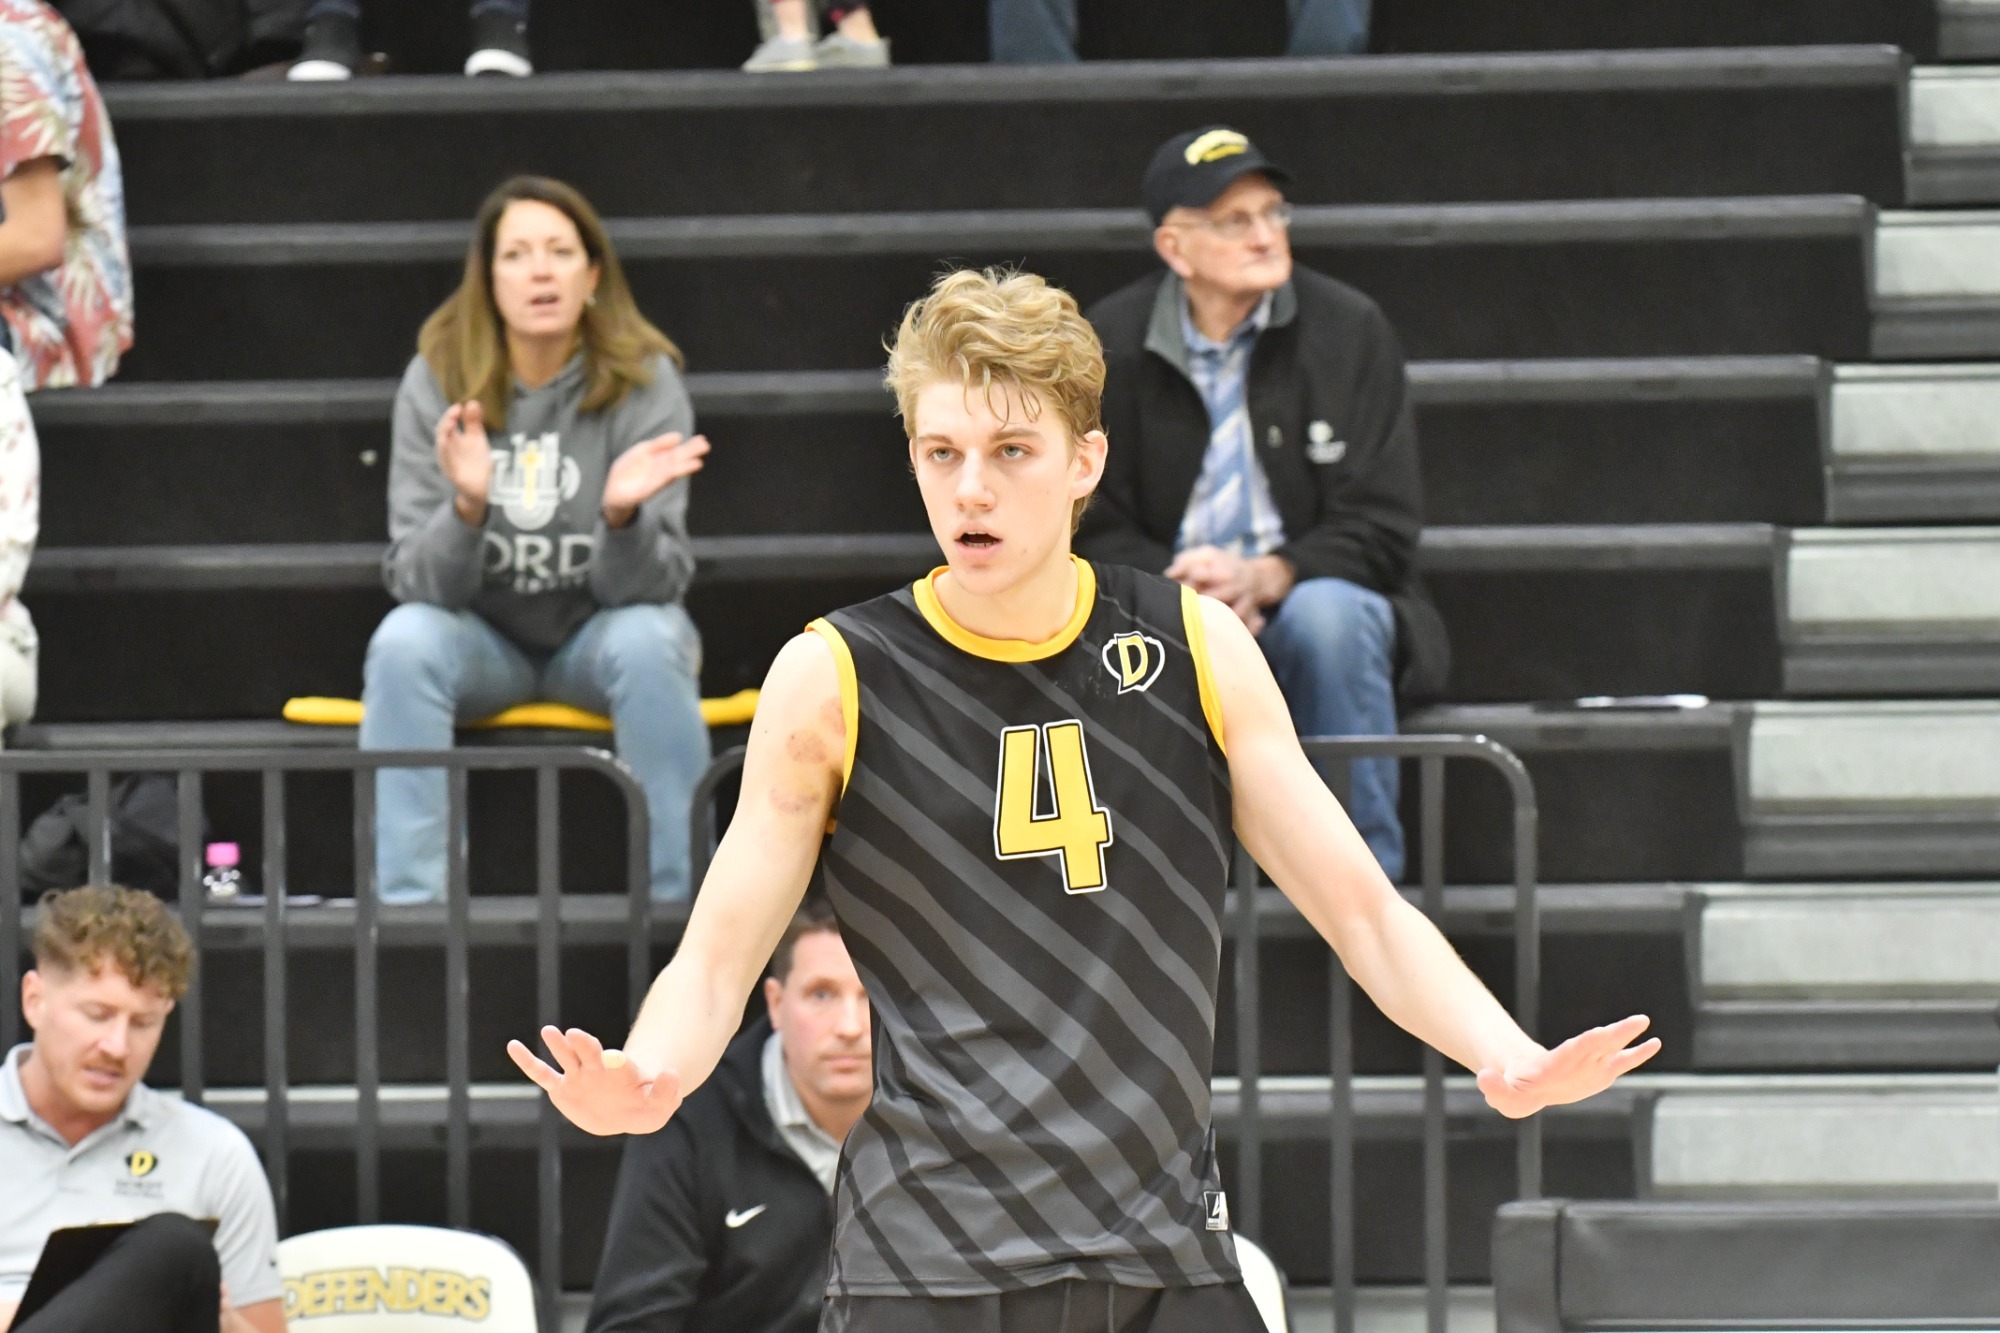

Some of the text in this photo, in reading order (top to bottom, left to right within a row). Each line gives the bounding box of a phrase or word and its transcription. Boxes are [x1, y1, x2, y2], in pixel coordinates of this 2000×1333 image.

[1114, 631, 1150, 693] D
[993, 719, 1113, 895] 4
[130, 1150, 154, 1177] D
[282, 1266, 491, 1322] DEFENDERS
